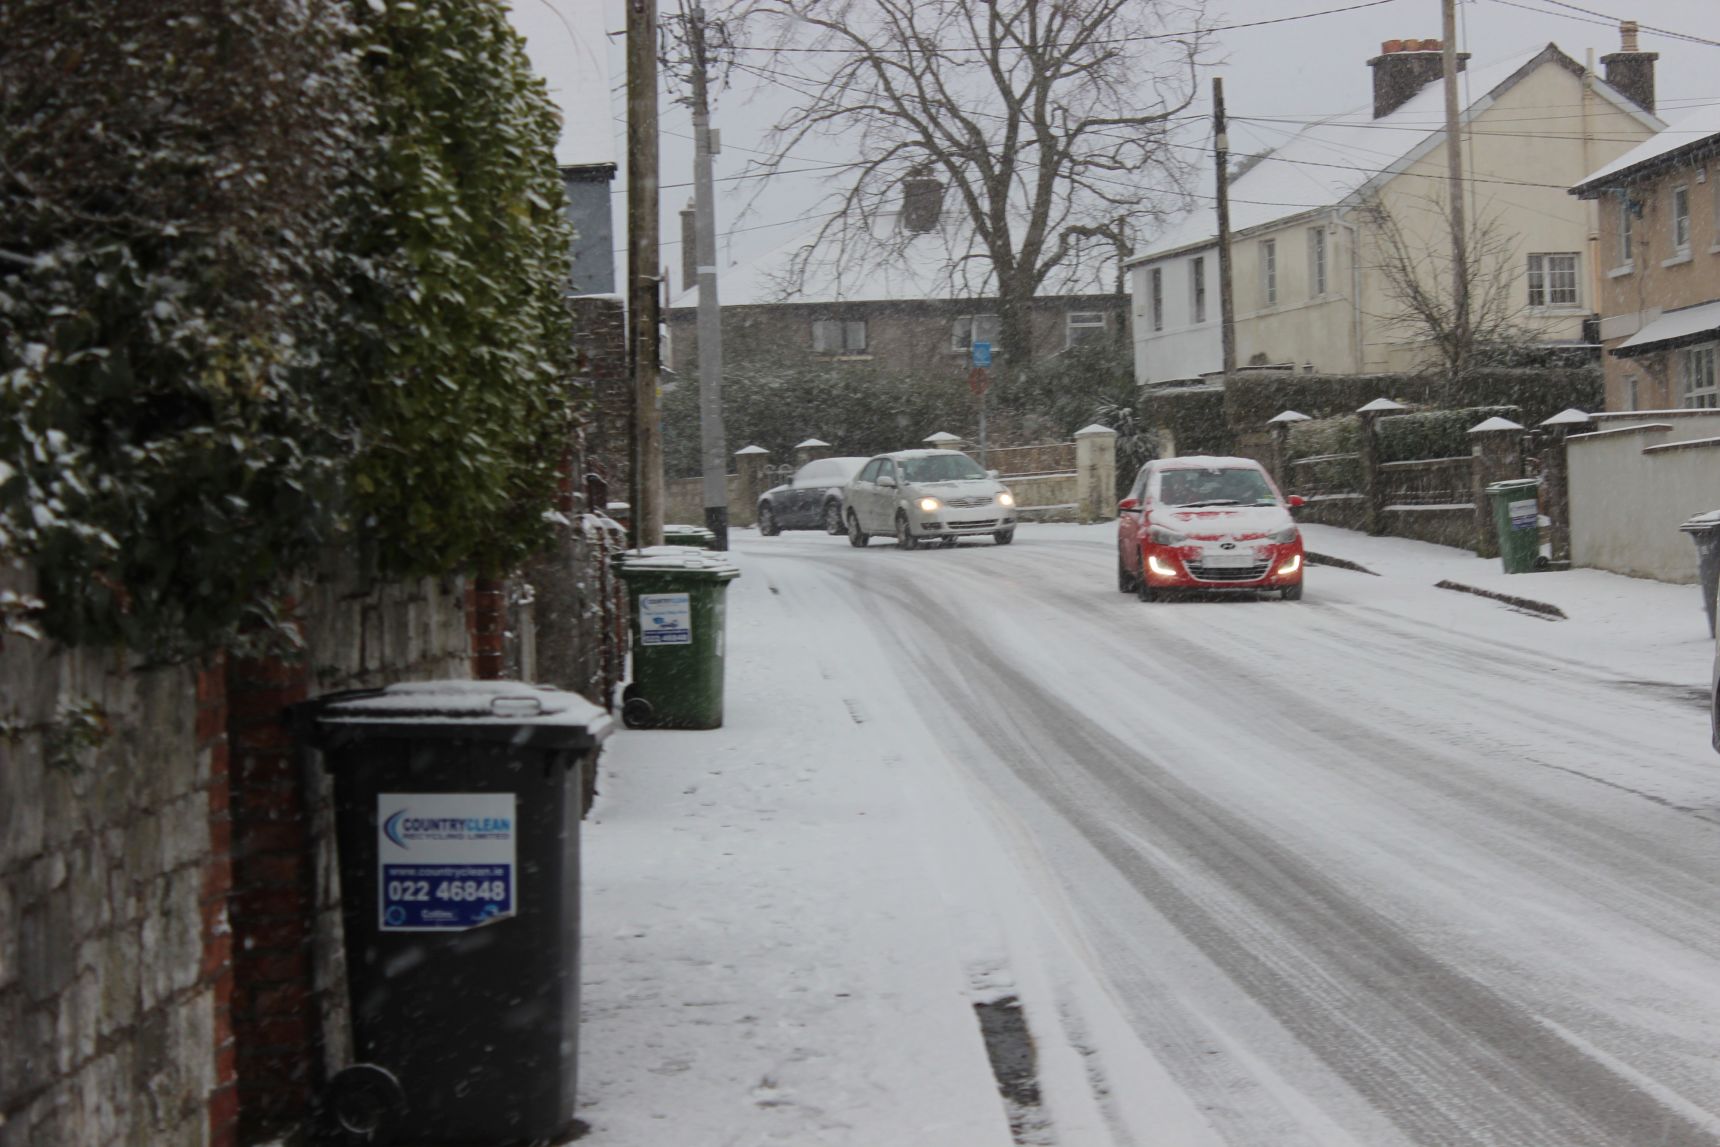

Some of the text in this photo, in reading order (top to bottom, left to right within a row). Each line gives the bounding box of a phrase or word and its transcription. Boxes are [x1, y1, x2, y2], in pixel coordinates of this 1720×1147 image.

[403, 818, 511, 832] COUNTRYCLEAN
[388, 881, 505, 901] 022 46848
